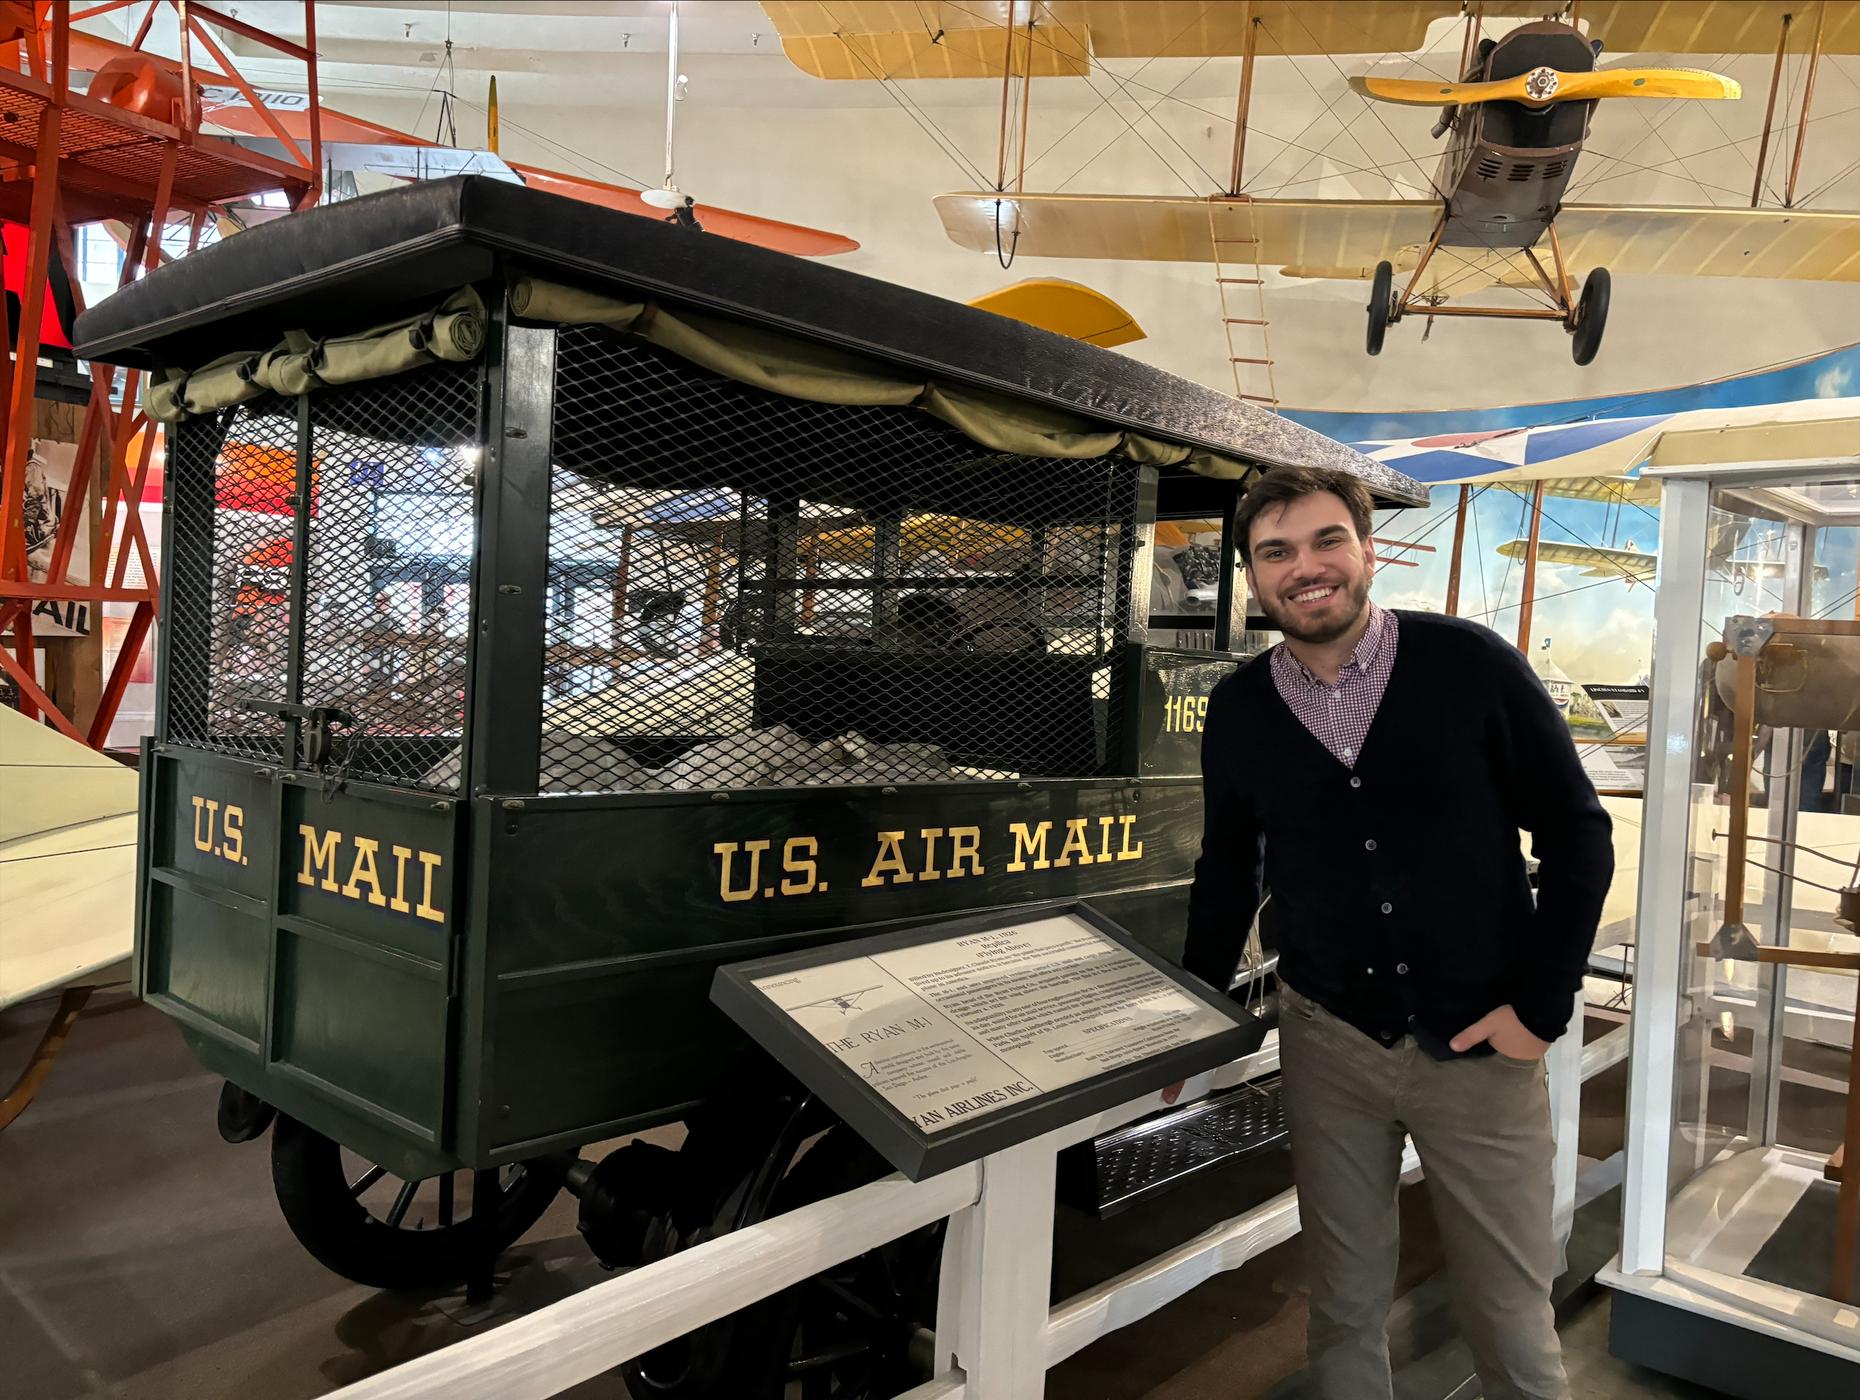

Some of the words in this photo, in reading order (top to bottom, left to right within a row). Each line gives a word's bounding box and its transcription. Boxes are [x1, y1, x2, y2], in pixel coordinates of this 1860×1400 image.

[1164, 696, 1209, 732] 1169
[192, 796, 248, 866] U.S.
[297, 824, 445, 923] MAIL
[713, 840, 828, 902] U.S.
[861, 826, 984, 887] AIR
[1006, 815, 1143, 873] MAIL
[976, 949, 1006, 957] (Flying
[1005, 943, 1031, 951] Above)
[981, 940, 1011, 949] Replica
[827, 1038, 859, 1052] THE
[861, 1024, 904, 1043] RYAN
[946, 1090, 1006, 1117] AIRLINES
[1004, 1082, 1033, 1096] INC.
